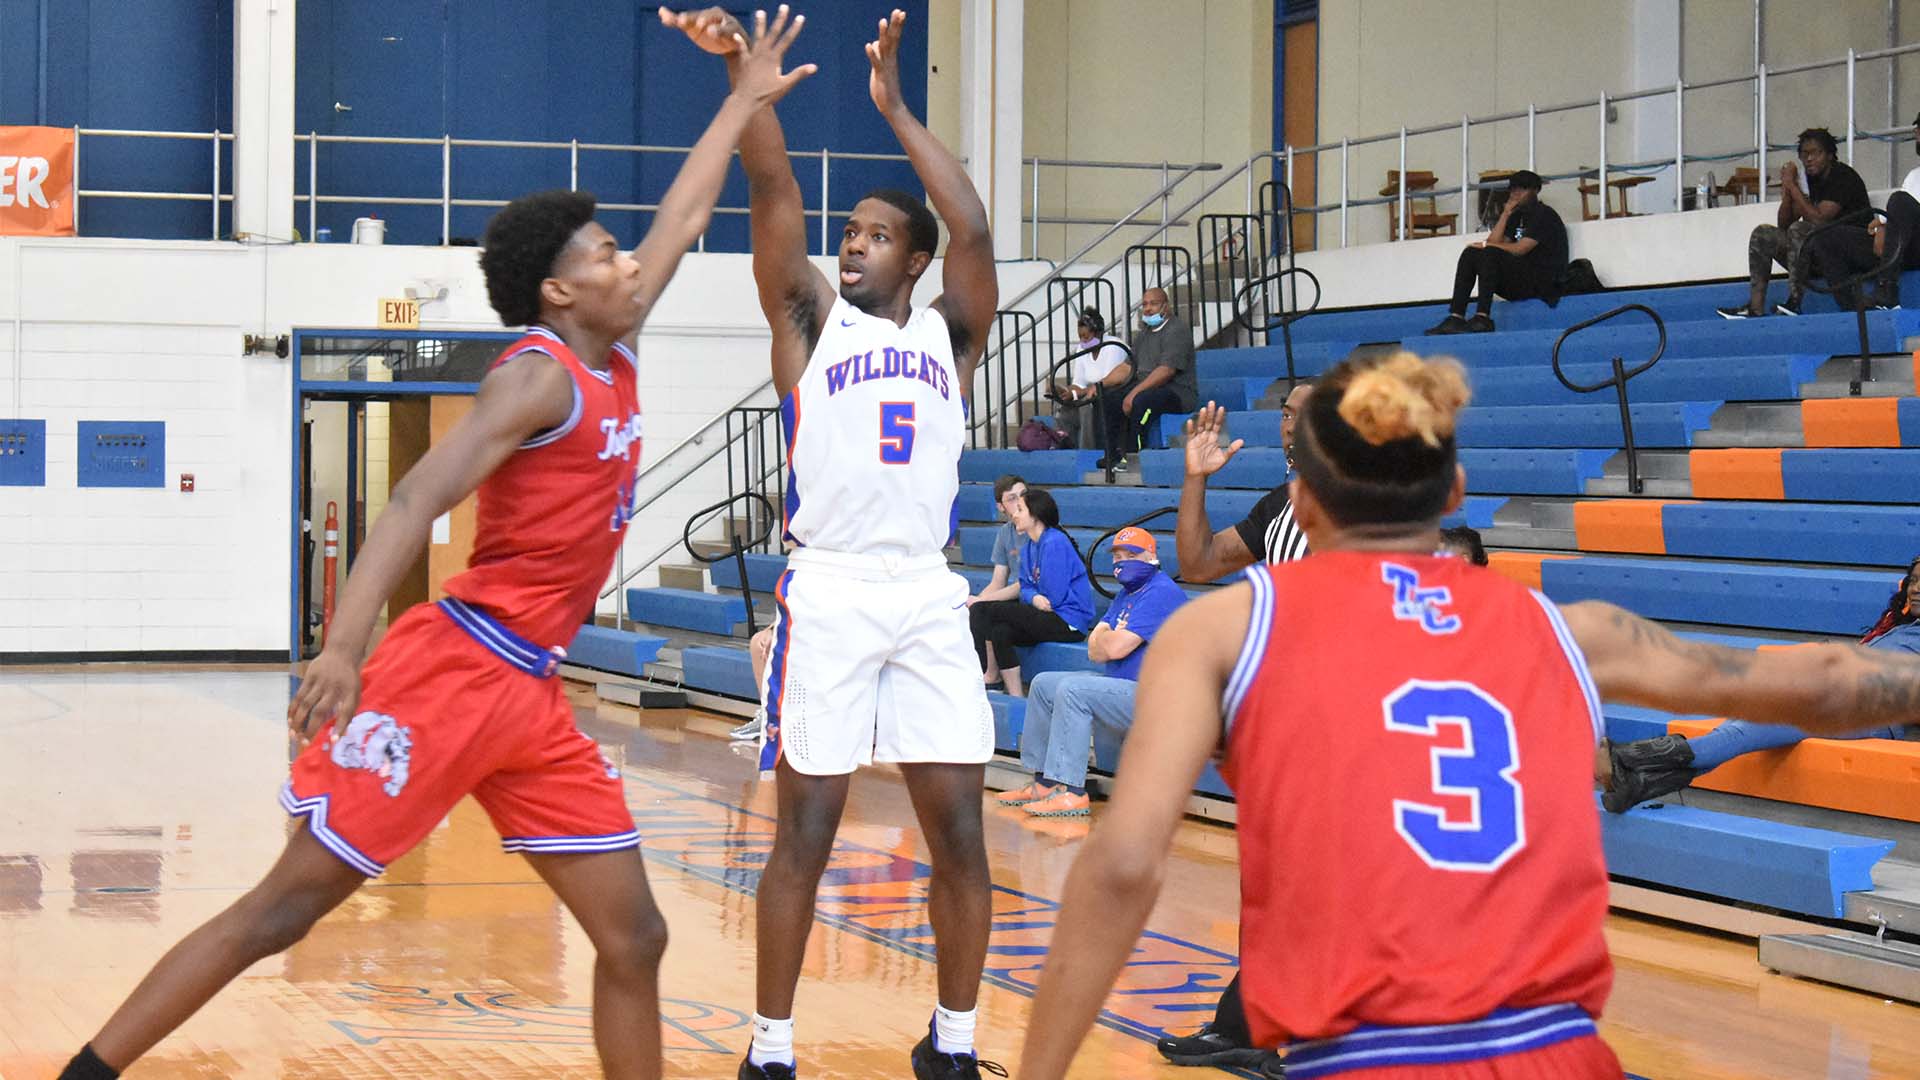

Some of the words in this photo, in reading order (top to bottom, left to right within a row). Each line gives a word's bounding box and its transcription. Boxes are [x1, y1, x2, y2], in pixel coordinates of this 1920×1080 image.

[385, 302, 413, 323] EXIT
[825, 347, 950, 401] WILDCATS
[879, 401, 915, 465] 5
[1381, 678, 1527, 873] 3
